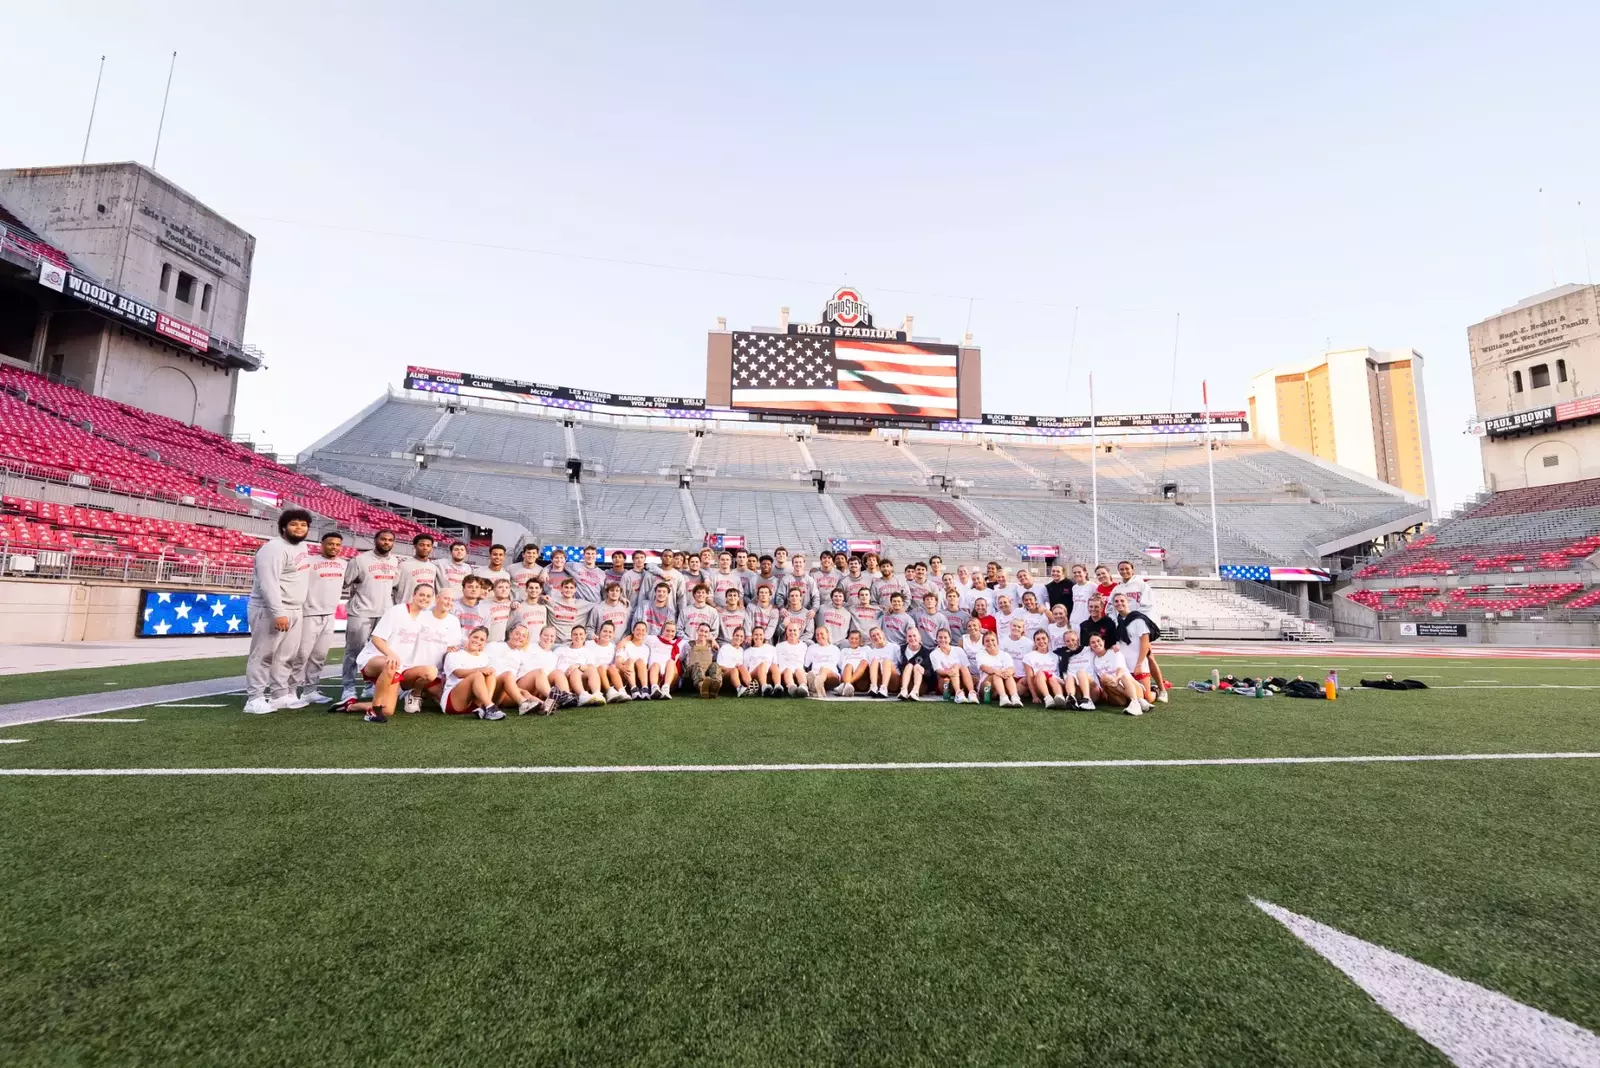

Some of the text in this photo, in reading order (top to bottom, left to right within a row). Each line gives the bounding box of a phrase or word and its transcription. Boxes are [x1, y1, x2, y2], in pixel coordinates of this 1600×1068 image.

[170, 223, 185, 235] and
[165, 229, 222, 267] Football Center
[68, 275, 117, 305] WOODY
[118, 296, 158, 323] HAYES
[797, 324, 897, 340] OHIO STADIUM
[1481, 342, 1509, 353] William
[1561, 317, 1589, 330] Family
[1505, 335, 1564, 355] Stadium Center
[409, 372, 494, 389] AUER CRONIN CLINE
[530, 389, 554, 397] McCOY
[582, 390, 612, 399] WEXNER
[1486, 418, 1512, 430] PAUL
[1514, 408, 1552, 425] BROWN
